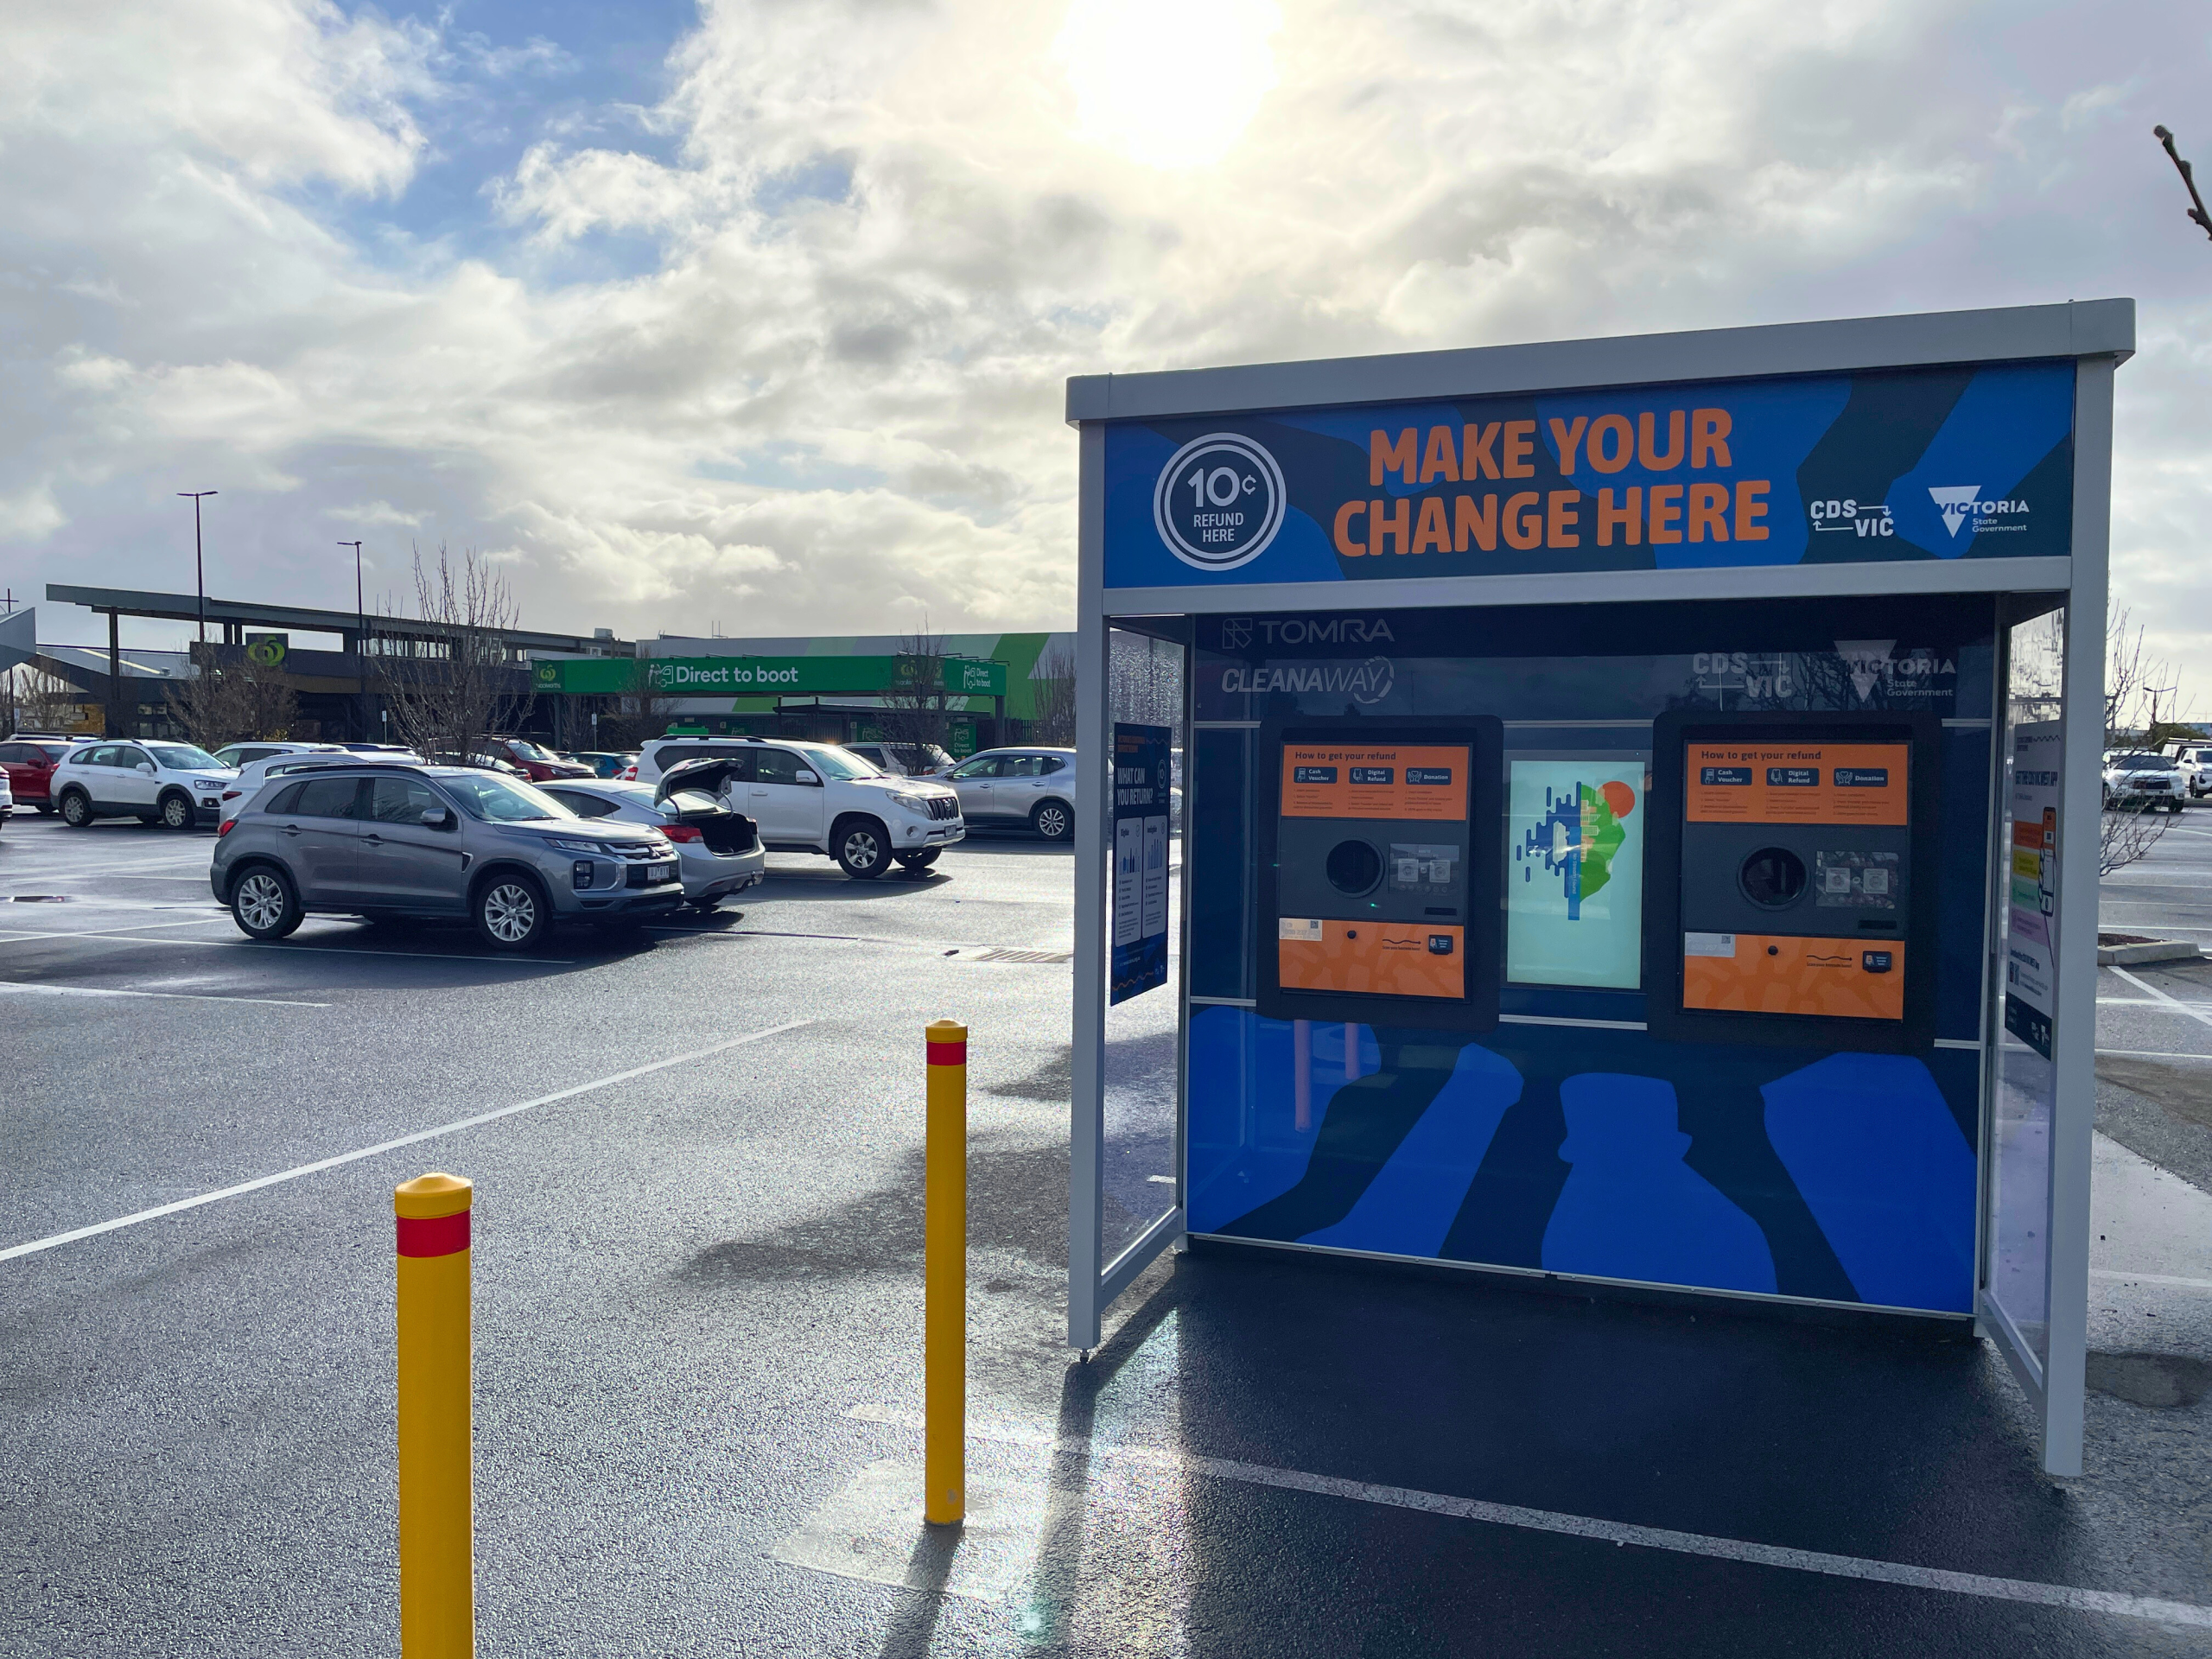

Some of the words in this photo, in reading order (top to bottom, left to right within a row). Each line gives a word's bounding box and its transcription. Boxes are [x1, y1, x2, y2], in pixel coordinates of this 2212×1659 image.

[1370, 420, 1536, 486] MAKE
[1548, 408, 1733, 476] YOUR
[1810, 499, 1858, 519] CDS
[1941, 499, 2031, 516] VICTORIA
[1193, 512, 1244, 528] REFUND
[1333, 489, 1581, 557] CHANGE
[1597, 480, 1771, 547] HERE
[1854, 518, 1894, 537] VIC
[1202, 528, 1236, 543] HERE
[1972, 524, 2028, 533] Government
[1258, 619, 1395, 645] TOMRA
[976, 667, 989, 677] Direct
[1693, 652, 1749, 674] CDS
[677, 665, 730, 683] Direct
[734, 667, 753, 683] to
[756, 665, 799, 683] boot
[981, 677, 991, 687] boot
[1221, 667, 1386, 694] CLEANAWAY
[1886, 678, 1918, 688] State
[1746, 675, 1793, 698] VIC
[1886, 688, 1954, 697] Government
[1294, 752, 1315, 760] How
[1329, 753, 1343, 762] get
[1345, 753, 1365, 762] your
[1367, 752, 1396, 760] refund
[1701, 751, 1725, 760] How
[1727, 751, 1738, 760] to
[1741, 752, 1758, 761] get
[1761, 753, 1784, 761] your
[1787, 751, 1821, 760] refund
[1116, 767, 1135, 785] WHAT
[1134, 767, 1146, 785] CAN
[1116, 788, 1129, 805] YOU
[1129, 787, 1154, 805] RETURN?
